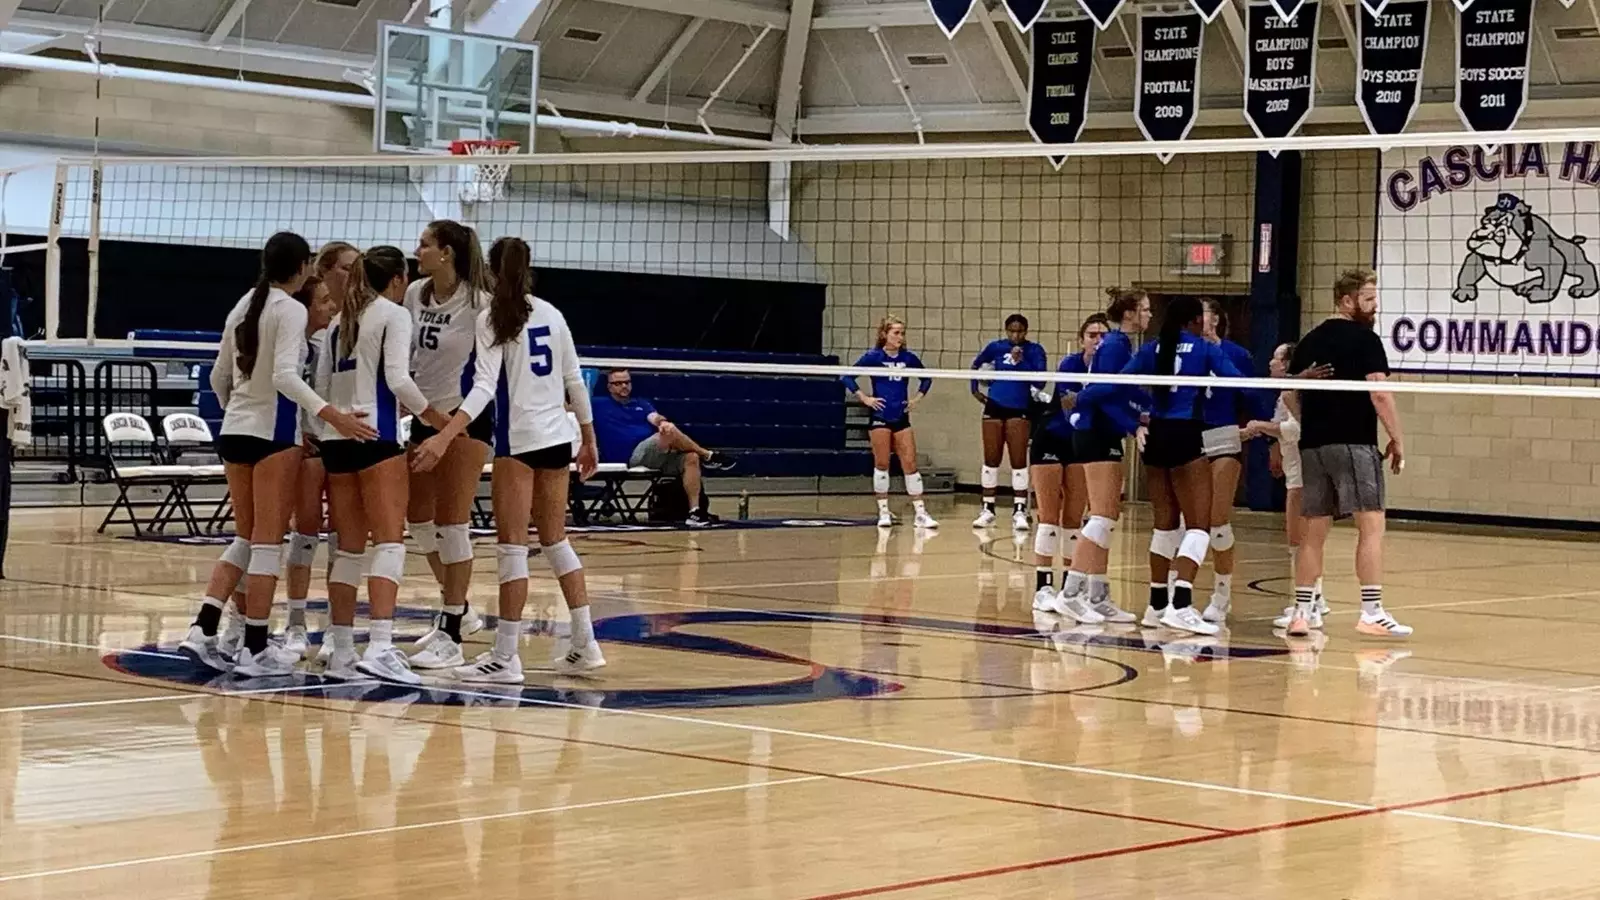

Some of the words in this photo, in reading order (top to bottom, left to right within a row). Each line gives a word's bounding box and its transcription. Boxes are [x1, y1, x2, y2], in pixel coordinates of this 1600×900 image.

[1374, 14, 1412, 27] STATE
[1476, 10, 1515, 24] STATE
[1051, 31, 1076, 44] STATE
[1154, 26, 1187, 40] STATE
[1465, 31, 1526, 46] CHAMPION
[1255, 37, 1309, 52] CHAMPION
[1144, 46, 1199, 62] CHAMPIONS
[1266, 57, 1294, 71] BOYS
[1362, 70, 1384, 83] OYS
[1460, 68, 1486, 81] BOYS
[1488, 66, 1525, 81] SOCCE
[1144, 80, 1193, 94] FOOTBAL
[1375, 90, 1402, 103] 2010
[1480, 94, 1506, 108] 2011
[1155, 105, 1183, 118] 2009
[1387, 142, 1551, 212] CASCIA
[419, 326, 441, 350] 15
[1391, 317, 1600, 357] COMMAND
[527, 325, 553, 377] 5
